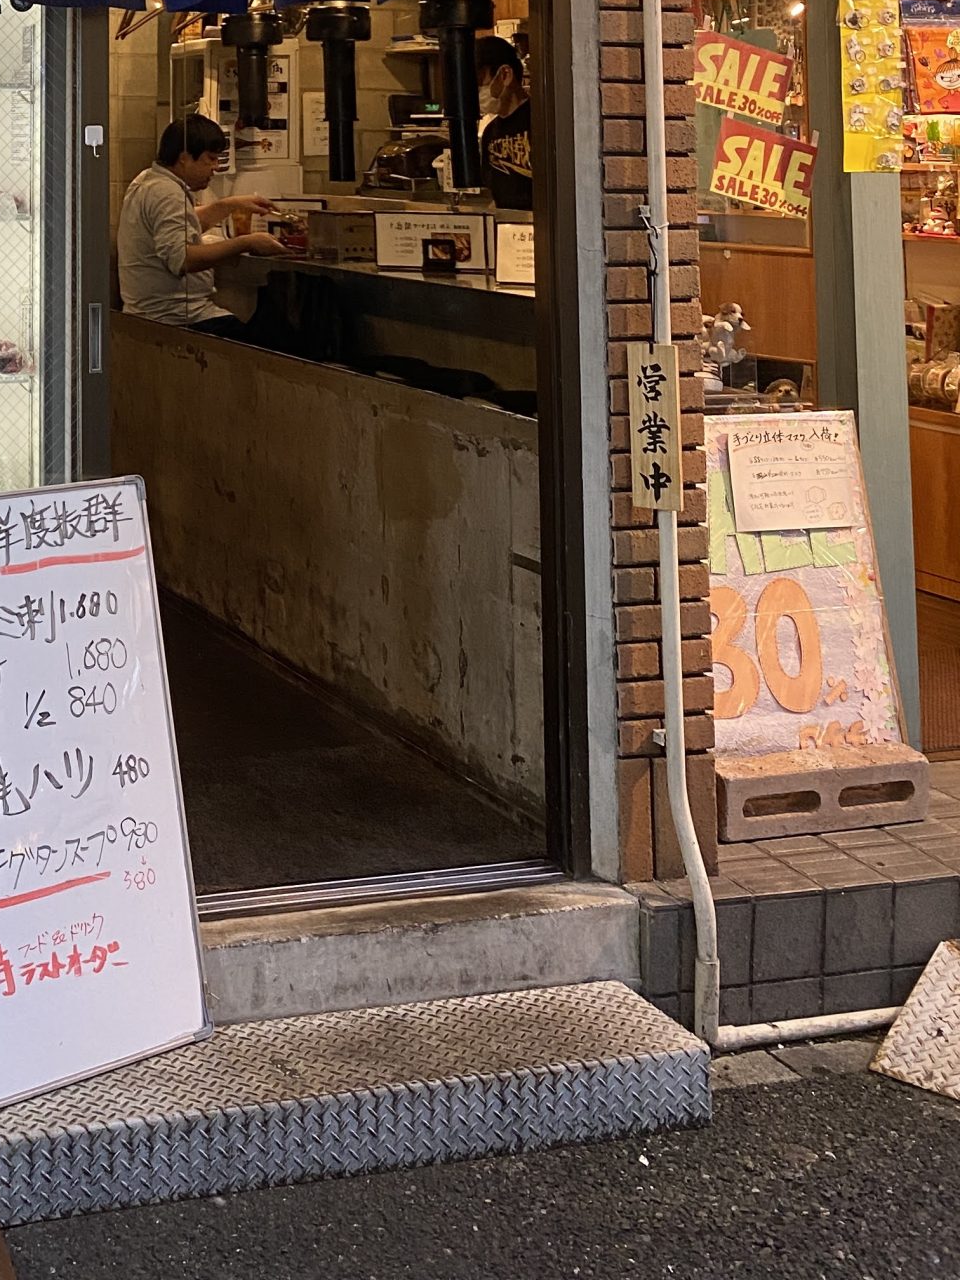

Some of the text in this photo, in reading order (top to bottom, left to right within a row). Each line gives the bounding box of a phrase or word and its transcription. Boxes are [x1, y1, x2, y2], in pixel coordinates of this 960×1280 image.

[695, 42, 788, 100] SALE
[717, 135, 813, 196] SALE
[637, 363, 672, 504] 営業中
[67, 681, 118, 718] 840
[111, 753, 150, 789] 480
